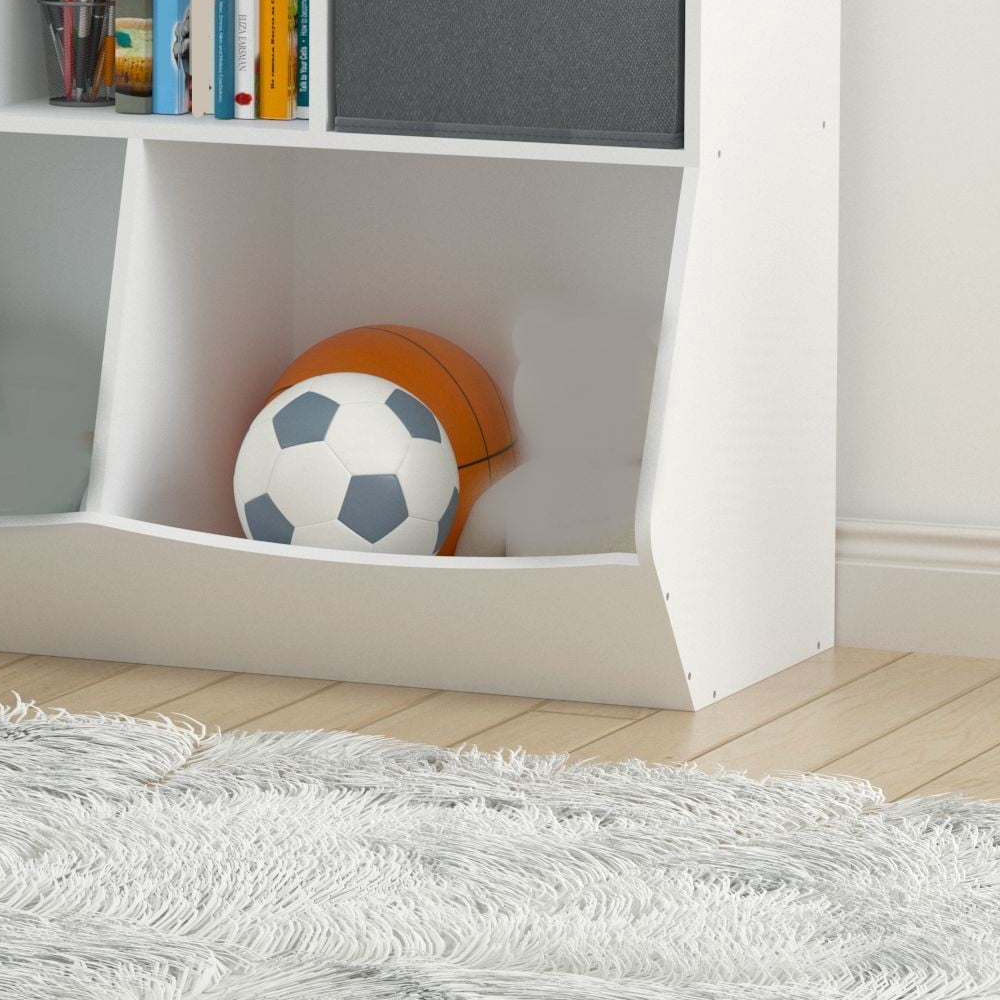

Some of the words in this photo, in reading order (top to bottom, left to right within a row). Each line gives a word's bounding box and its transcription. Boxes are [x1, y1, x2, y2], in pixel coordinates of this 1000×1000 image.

[238, 14, 247, 34] ELIZA
[238, 36, 247, 72] EARSMAN
[299, 82, 307, 92] Talk
